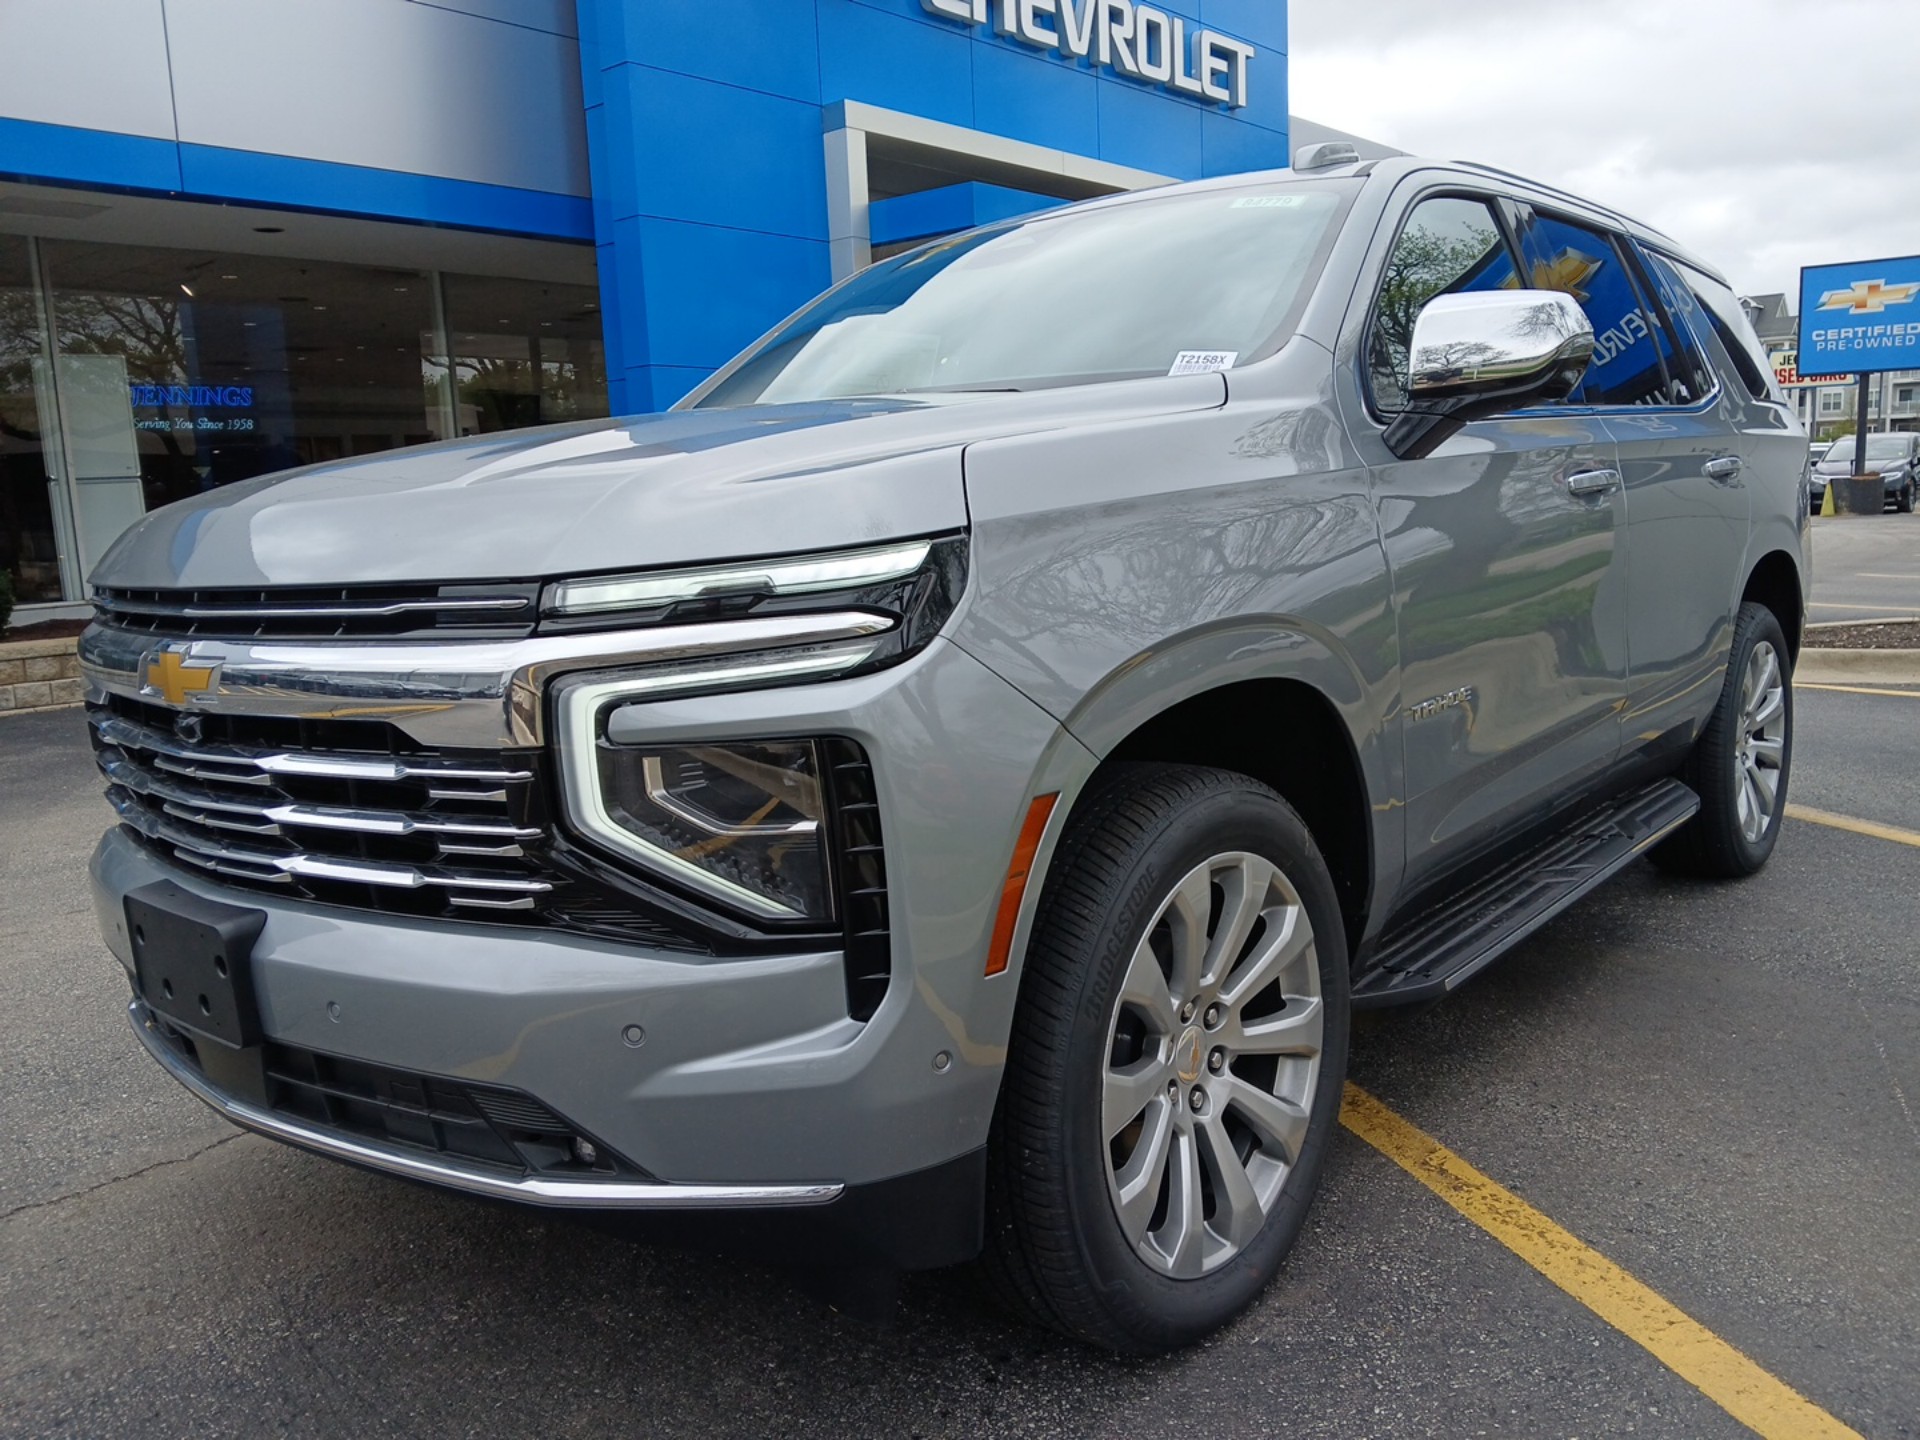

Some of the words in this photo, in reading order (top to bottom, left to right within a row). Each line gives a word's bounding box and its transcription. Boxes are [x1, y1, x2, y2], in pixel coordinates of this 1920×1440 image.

[1811, 322, 1920, 341] CERTIFIED
[1816, 335, 1916, 352] PRE-OWNED
[1180, 354, 1227, 365] T2158X
[131, 386, 252, 407] JENNINGS
[133, 417, 171, 432] Serving
[174, 417, 194, 430] You
[197, 417, 224, 430] Since
[228, 419, 254, 430] 1958
[1411, 684, 1472, 722] TAHOE
[1084, 862, 1159, 1024] BRIDGESTONE
